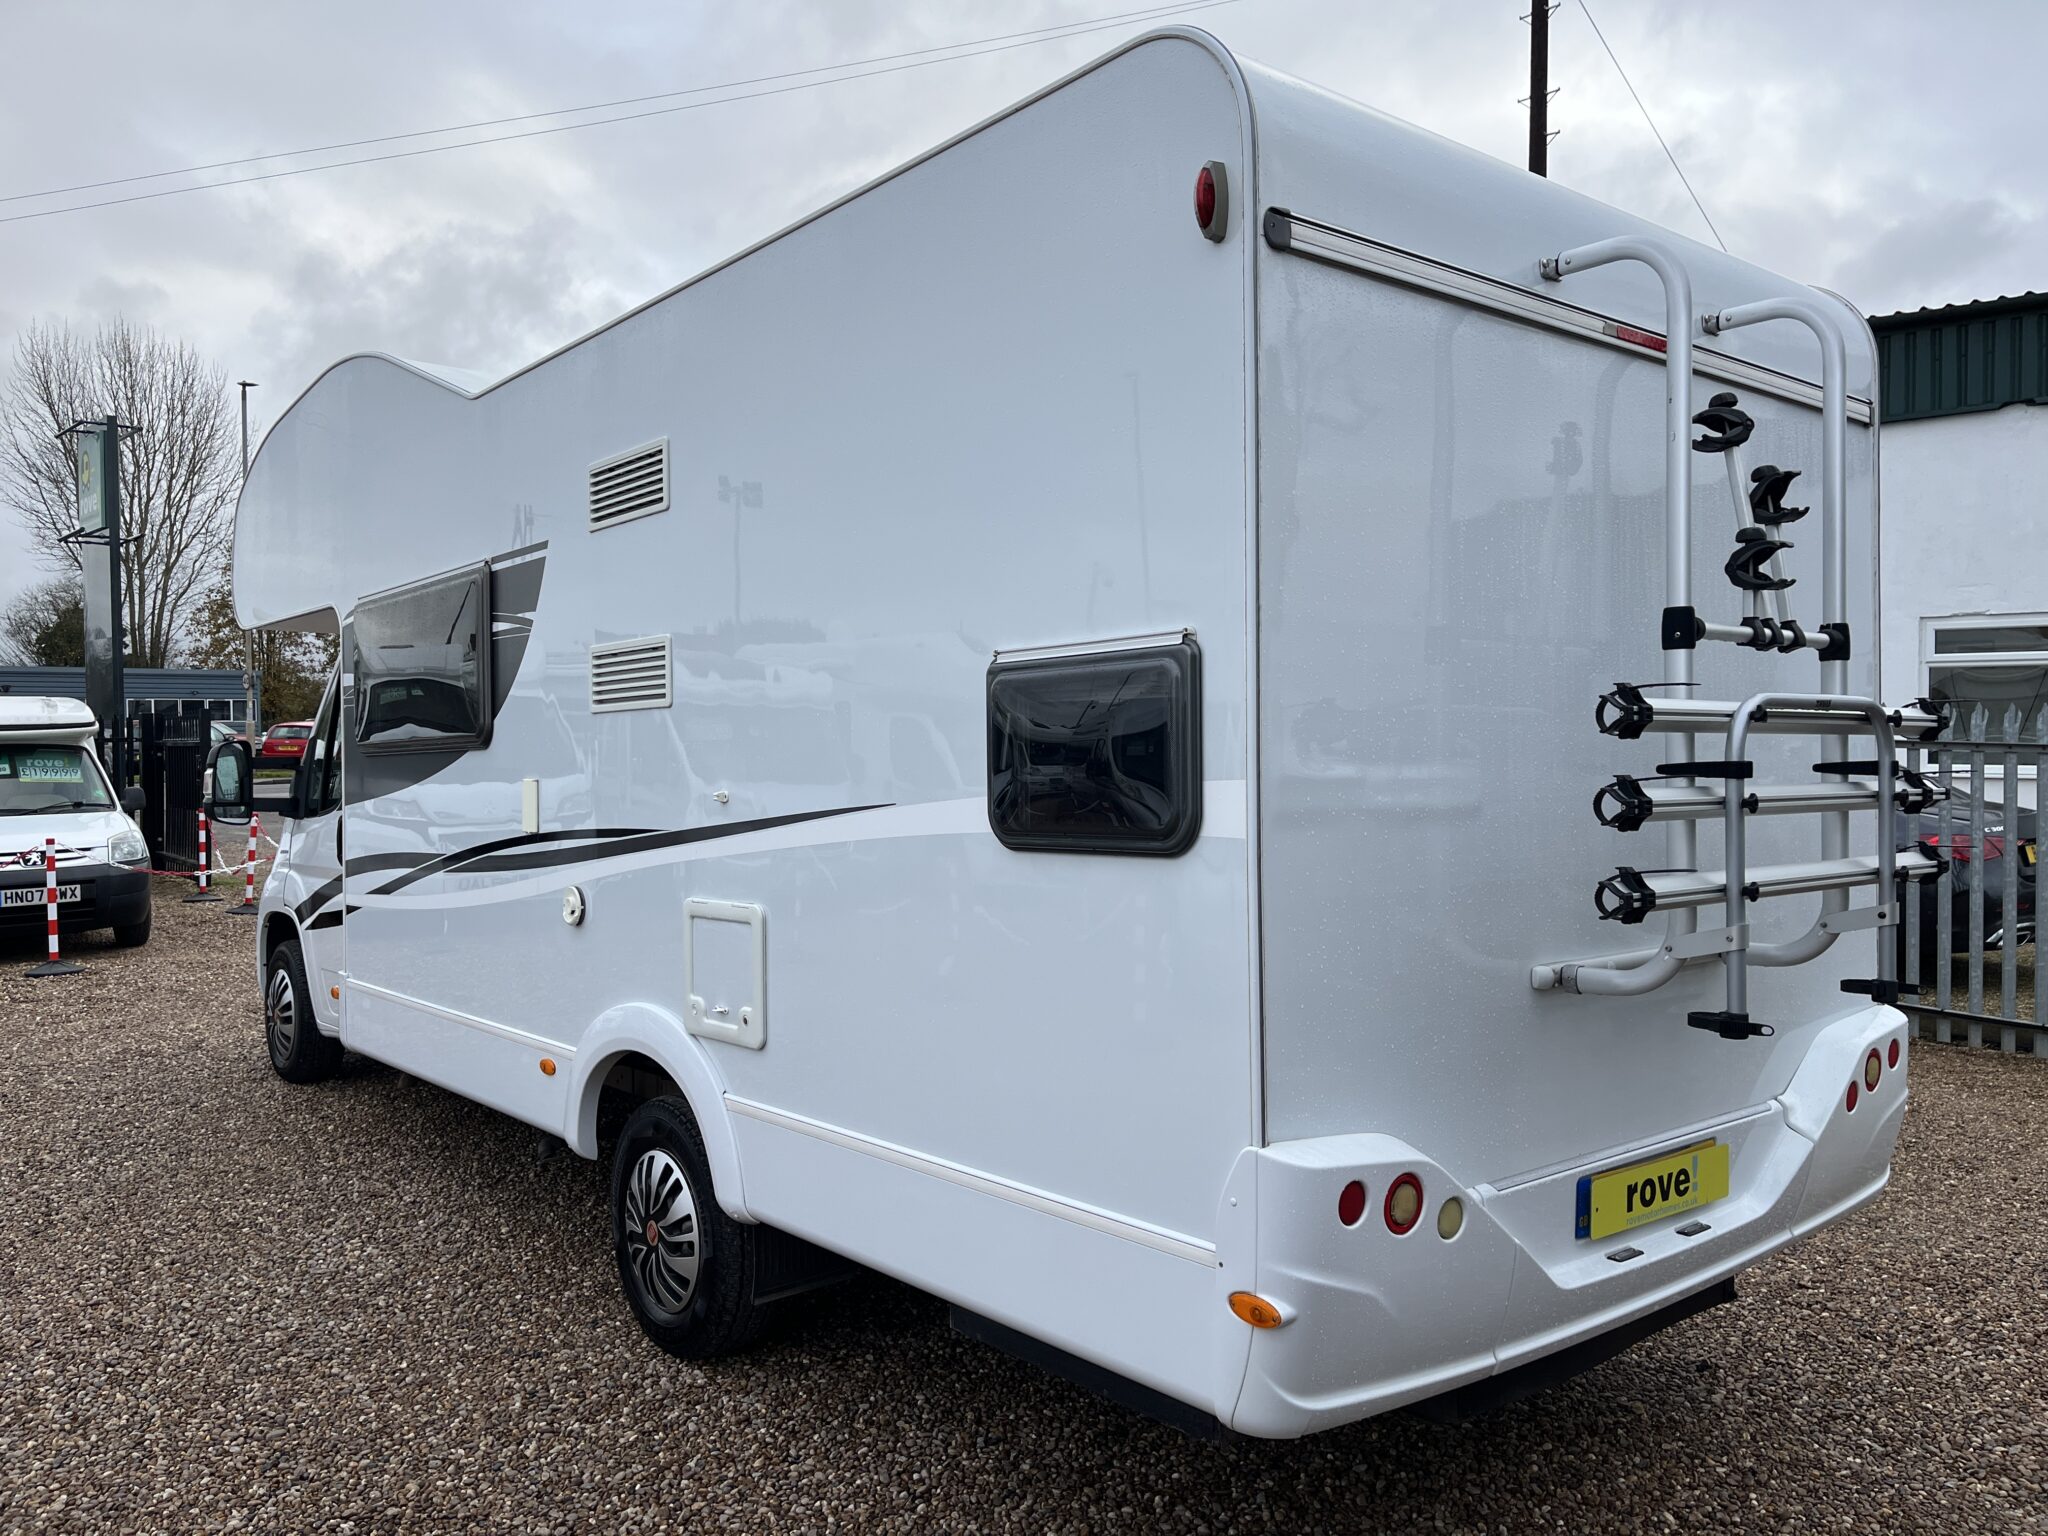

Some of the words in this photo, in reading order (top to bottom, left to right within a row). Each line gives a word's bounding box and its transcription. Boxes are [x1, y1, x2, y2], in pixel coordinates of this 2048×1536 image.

[21, 767, 79, 777] £19999
[4, 889, 44, 904] HN07
[55, 886, 78, 900] WX
[1627, 1155, 1698, 1213] rove!
